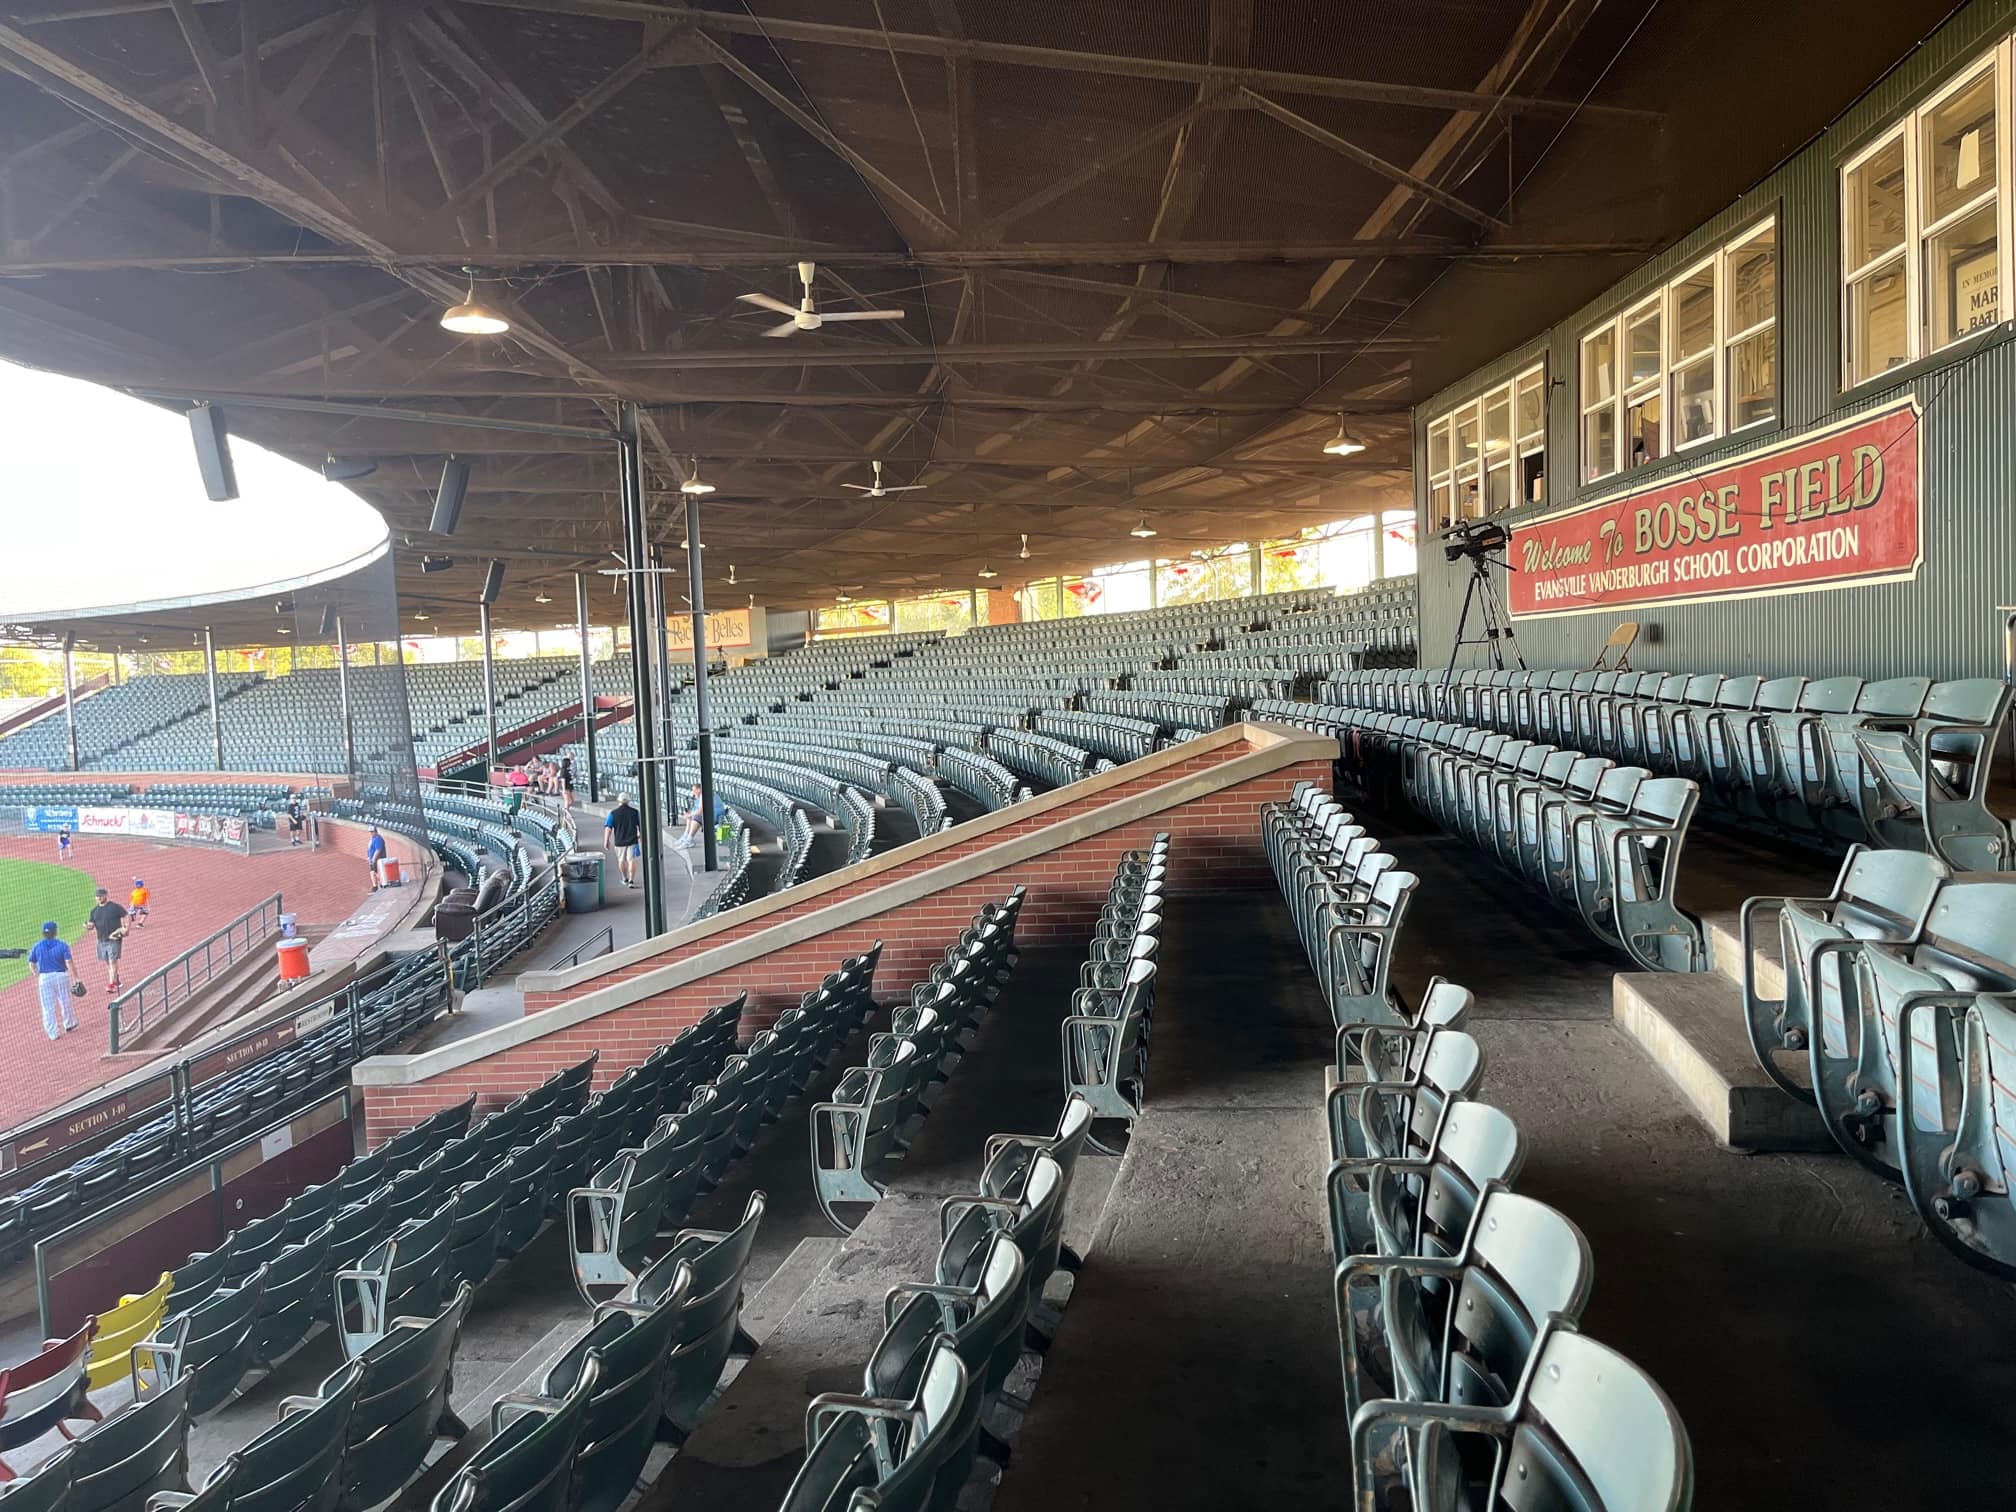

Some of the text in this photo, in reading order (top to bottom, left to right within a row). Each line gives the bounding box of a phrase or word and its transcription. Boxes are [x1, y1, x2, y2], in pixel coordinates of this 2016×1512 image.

[1522, 444, 1884, 575] Welcome To BOSSE FIELD
[1535, 524, 1859, 601] EVANSVILLE VANDERBURGH SCHOOL CORPORATION
[712, 616, 744, 644] Belles
[226, 1044, 254, 1064] SECTION
[68, 1111, 108, 1137] SECTION
